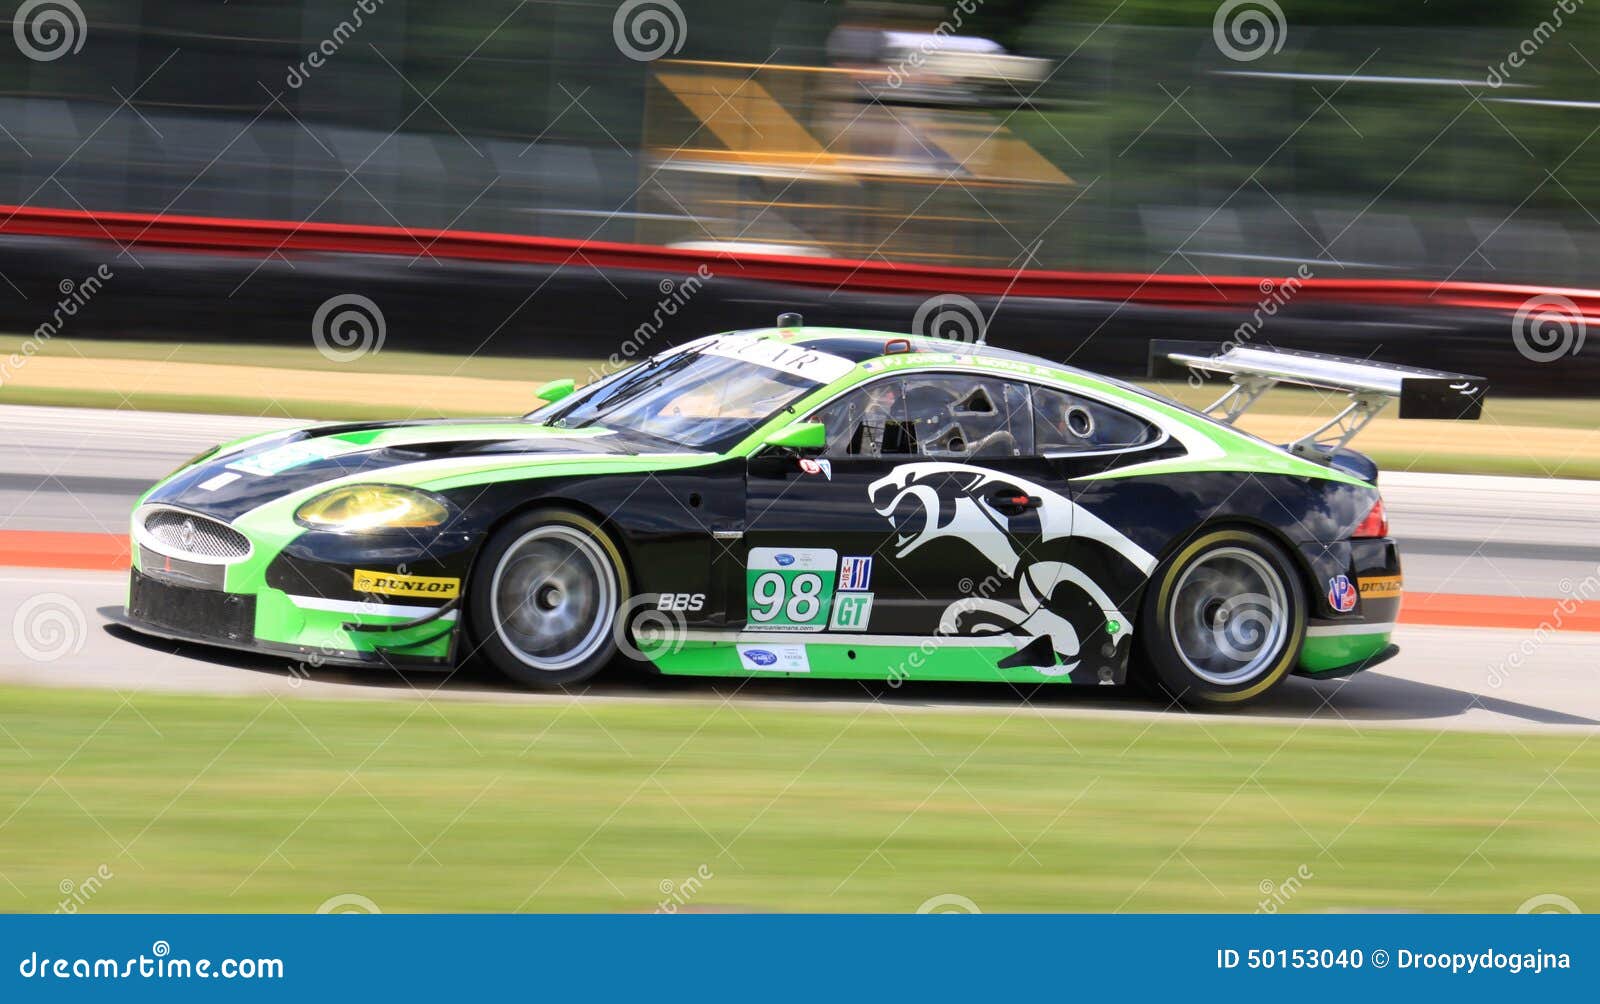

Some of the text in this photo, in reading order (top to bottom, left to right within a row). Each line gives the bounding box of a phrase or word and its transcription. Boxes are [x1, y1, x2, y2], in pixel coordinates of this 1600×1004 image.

[374, 577, 455, 593] DUNLOP
[657, 593, 706, 611] BBS
[750, 571, 823, 623] 98
[837, 597, 868, 626] GT
